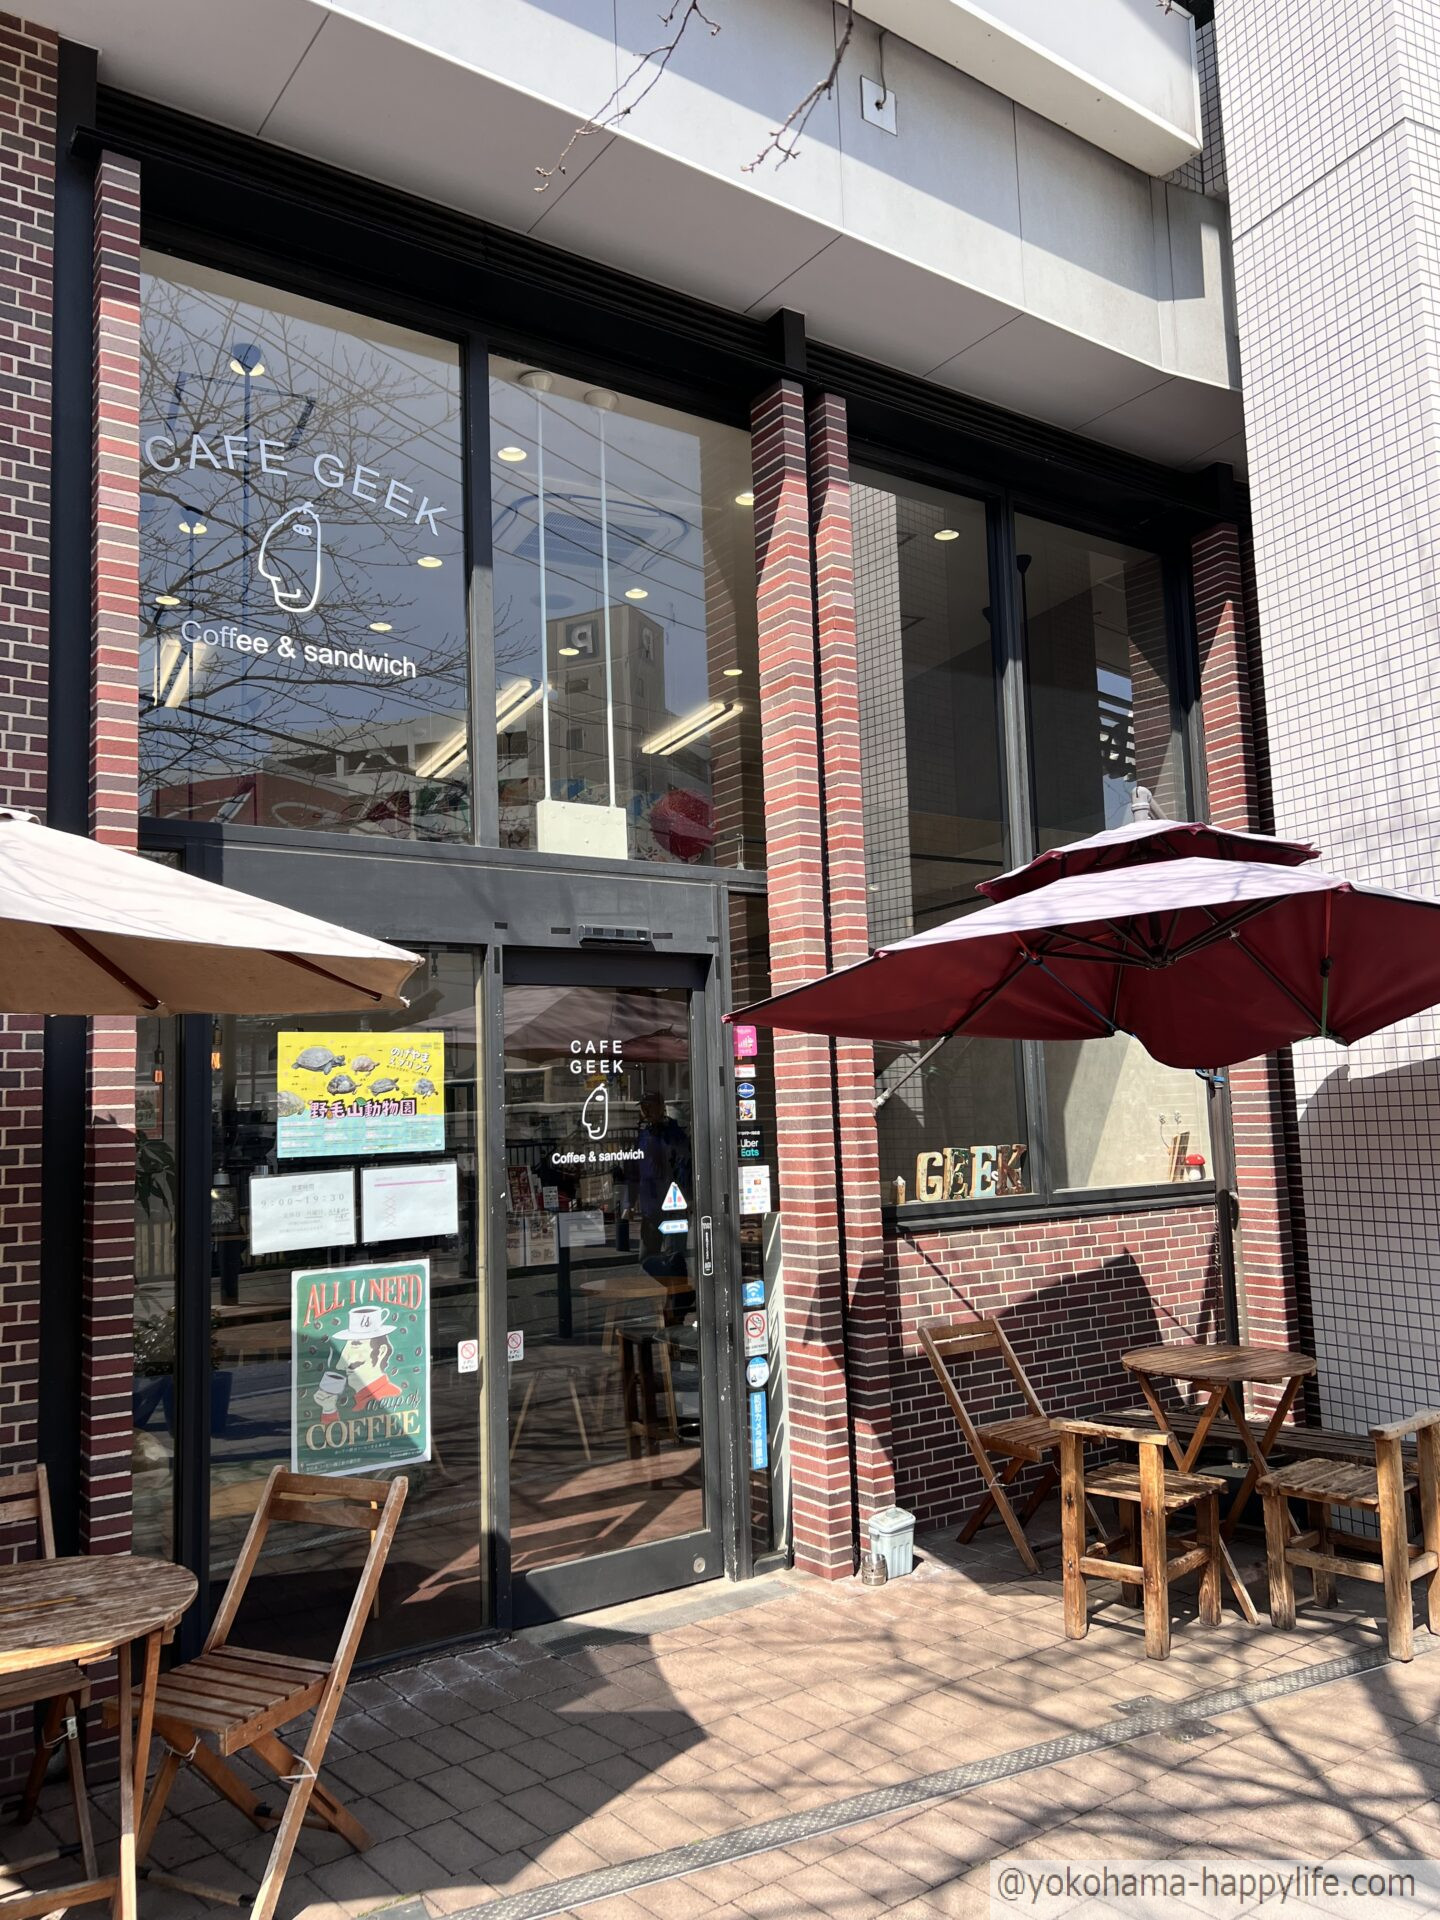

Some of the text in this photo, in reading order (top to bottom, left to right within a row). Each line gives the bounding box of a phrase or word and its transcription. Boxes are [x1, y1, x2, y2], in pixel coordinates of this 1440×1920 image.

[144, 434, 447, 536] CAFE GEEK
[181, 620, 417, 678] Coffee & sandwich
[570, 1040, 623, 1054] CAFE
[570, 1060, 623, 1074] GEEK
[308, 1097, 417, 1120] 野毛山動物園
[740, 1138, 759, 1148] Uber
[741, 1148, 760, 1157] Eats
[552, 1148, 645, 1164] Coffee & sandwich
[916, 1144, 1027, 1202] GEEK
[303, 1274, 423, 1327] ALL I NEED
[360, 1315, 371, 1328] is
[366, 1388, 422, 1412] a cup of
[305, 1410, 420, 1451] COFFEE
